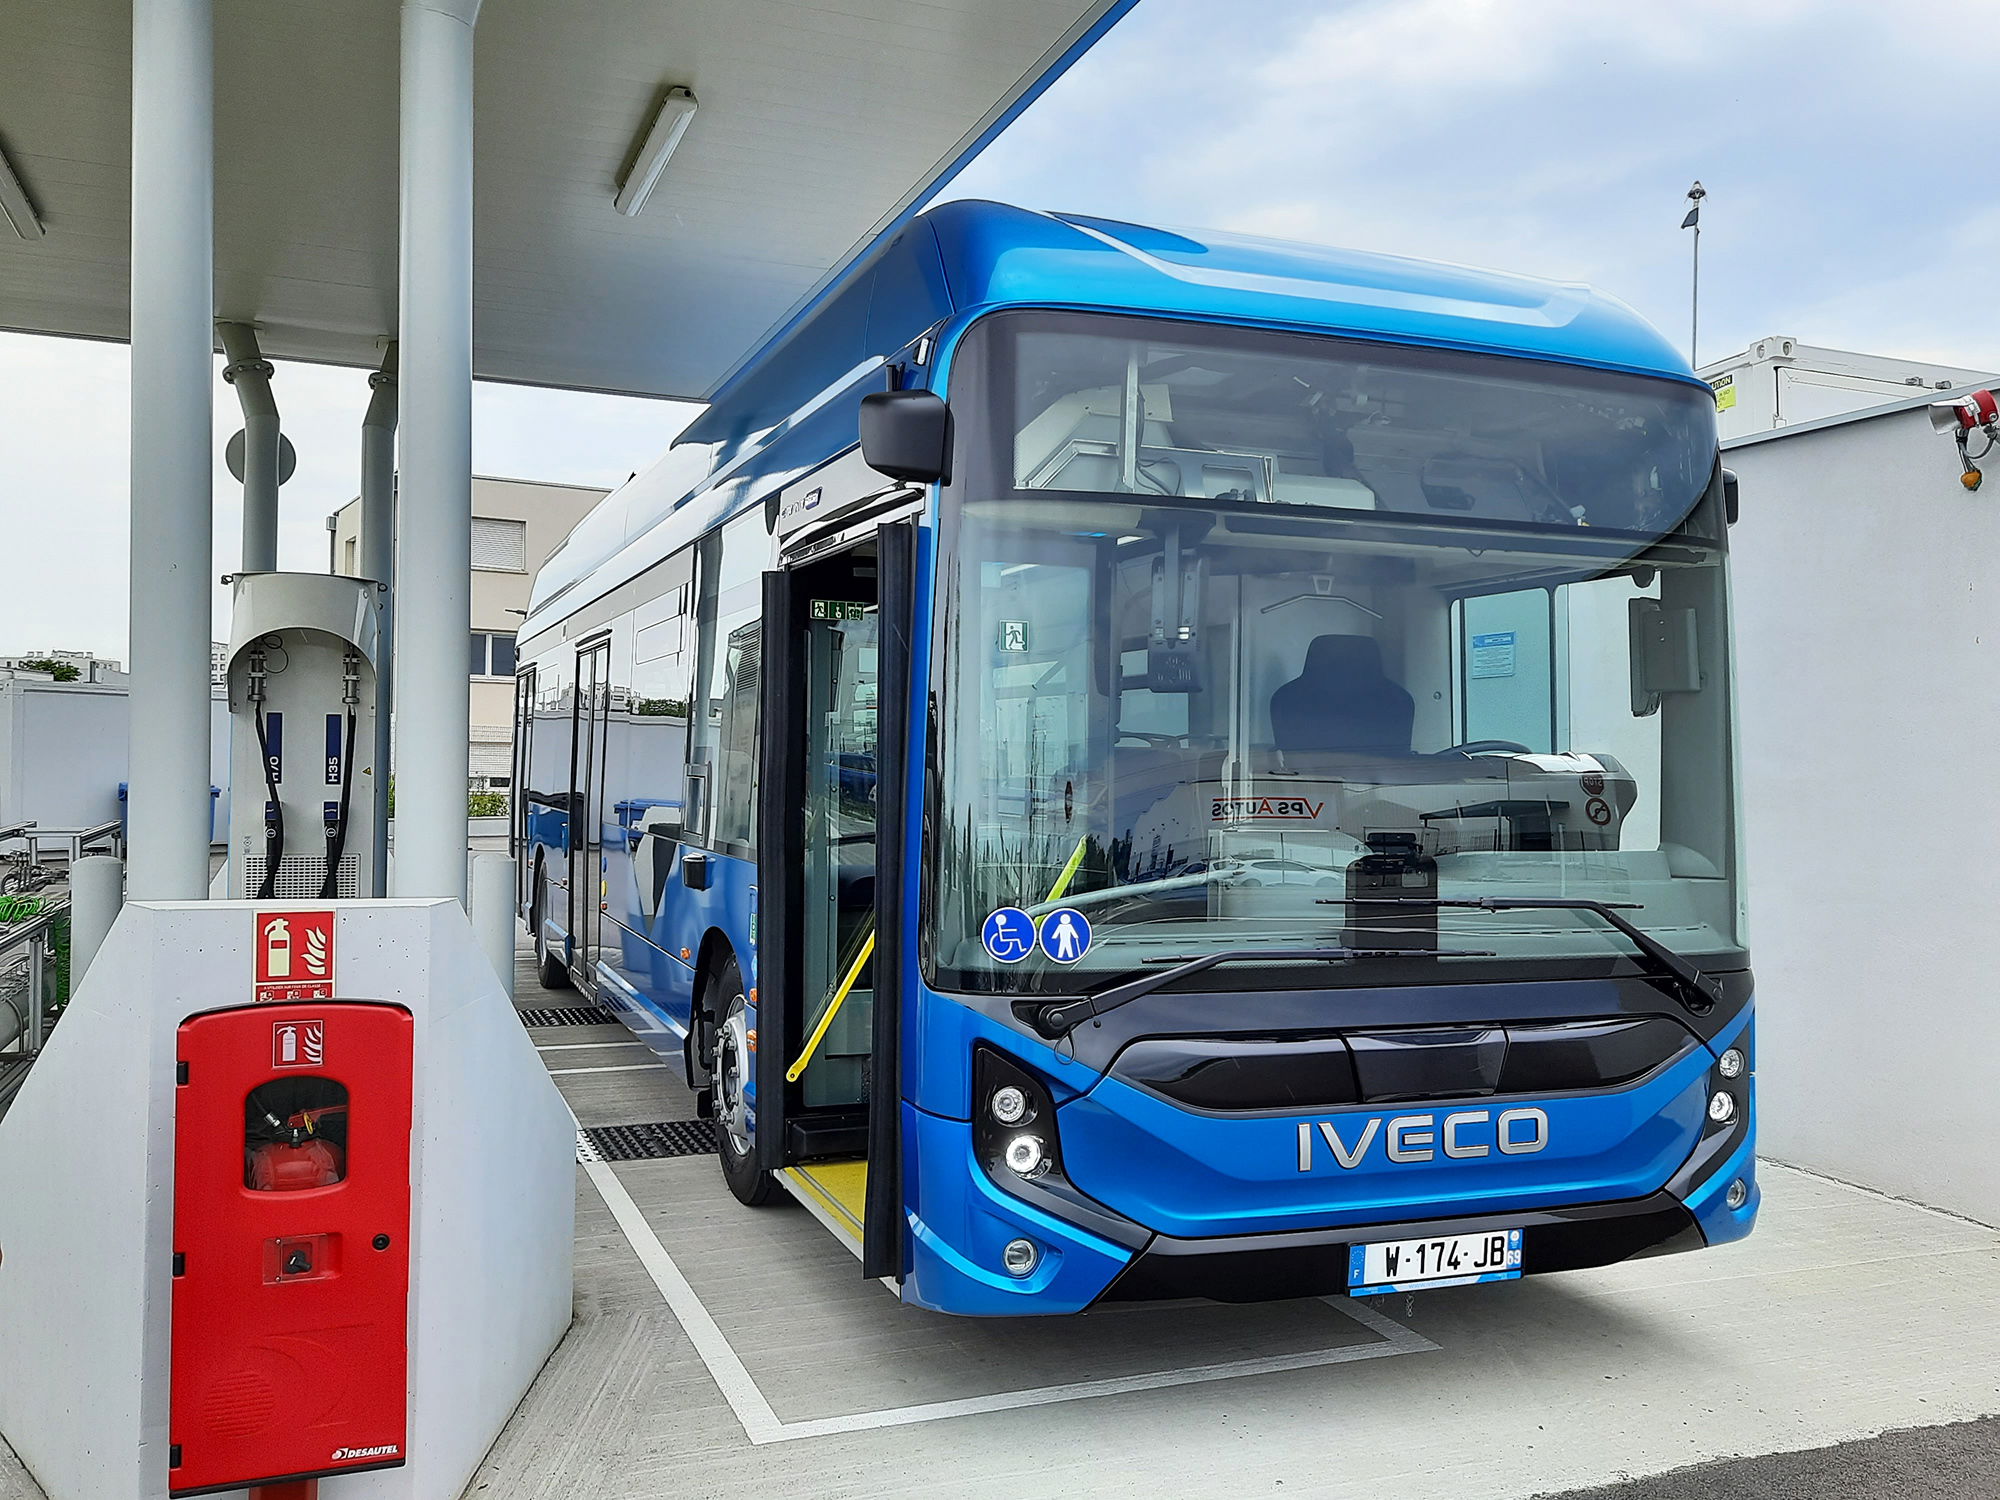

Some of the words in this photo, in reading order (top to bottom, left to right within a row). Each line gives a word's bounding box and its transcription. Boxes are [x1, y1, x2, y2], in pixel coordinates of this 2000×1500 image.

[328, 756, 338, 782] H35
[1298, 1107, 1549, 1172] IVECO
[1507, 1250, 1521, 1265] 69
[1353, 1269, 1360, 1279] F
[347, 1445, 398, 1458] DESAUTEL
